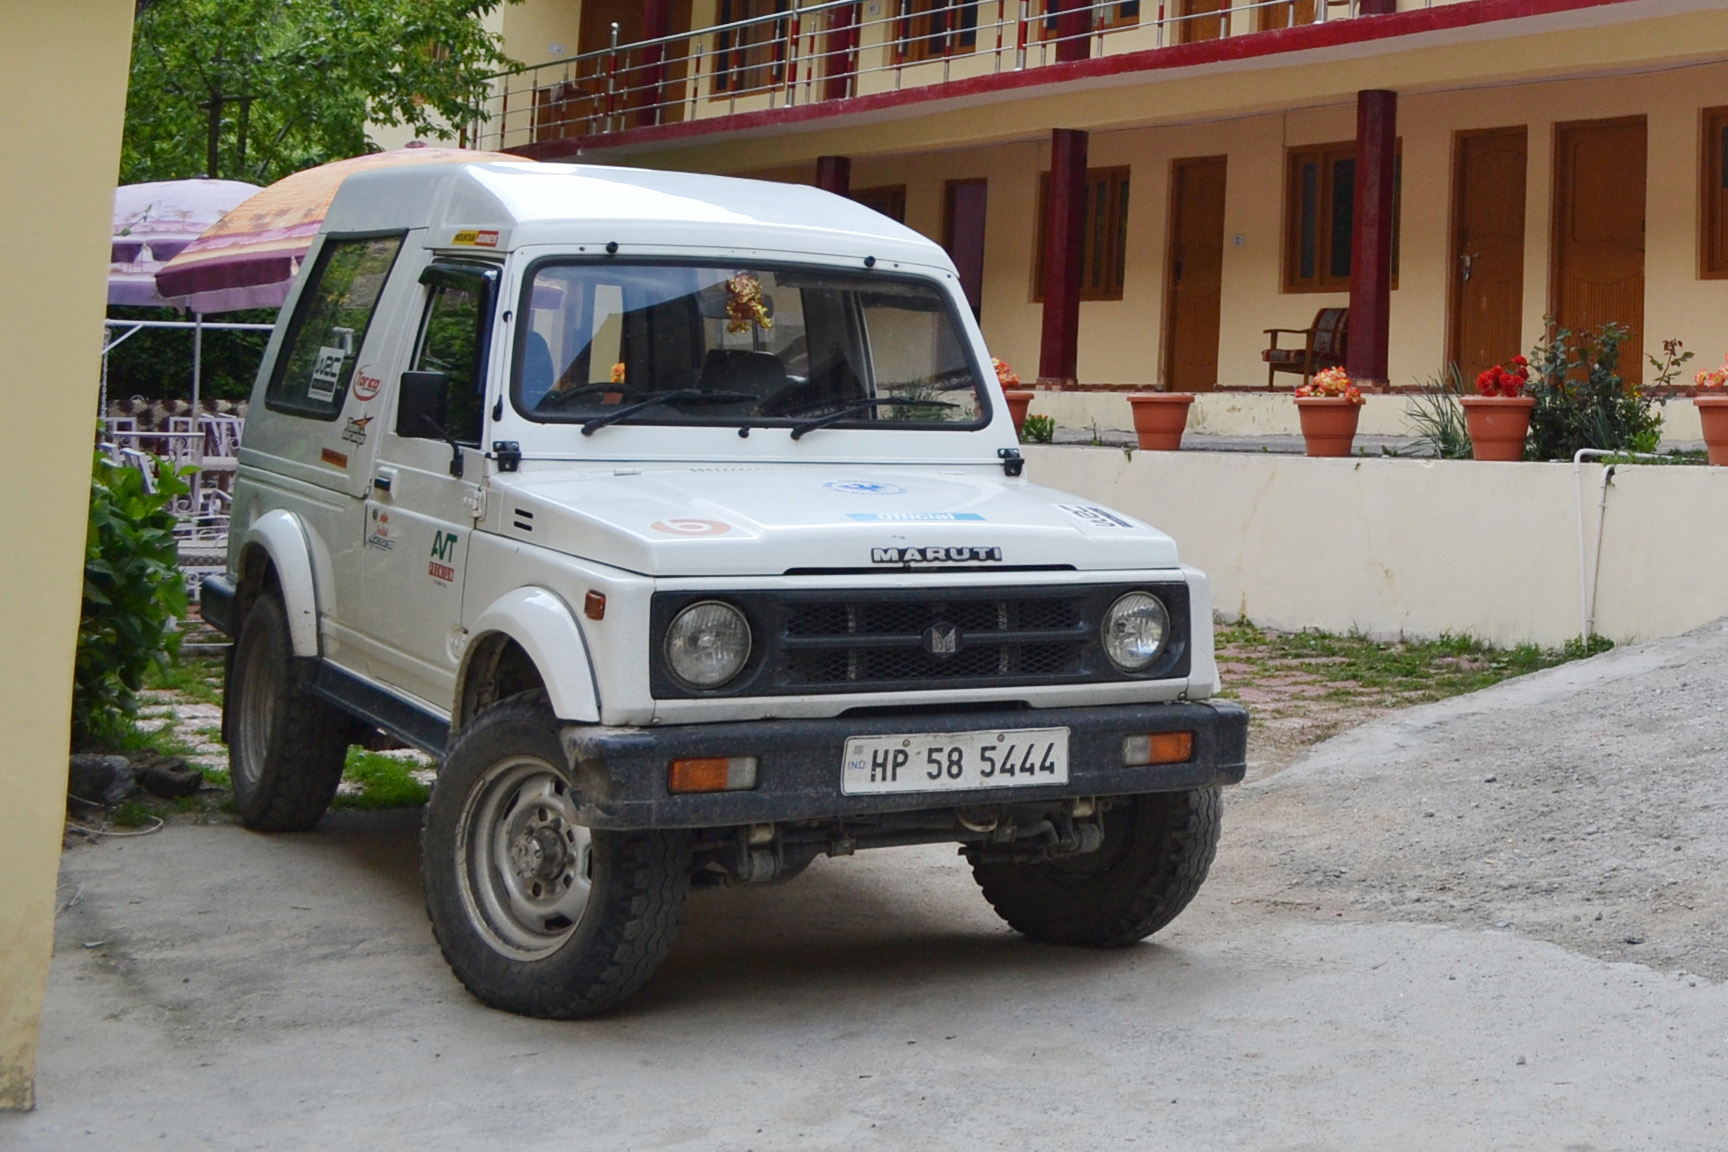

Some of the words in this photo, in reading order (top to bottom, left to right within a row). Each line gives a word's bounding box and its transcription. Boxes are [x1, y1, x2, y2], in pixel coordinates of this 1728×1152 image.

[430, 530, 458, 563] AVT
[871, 547, 1002, 562] MARUTI
[870, 749, 909, 782] HP
[926, 747, 964, 780] 58
[980, 743, 1055, 778] 5444
